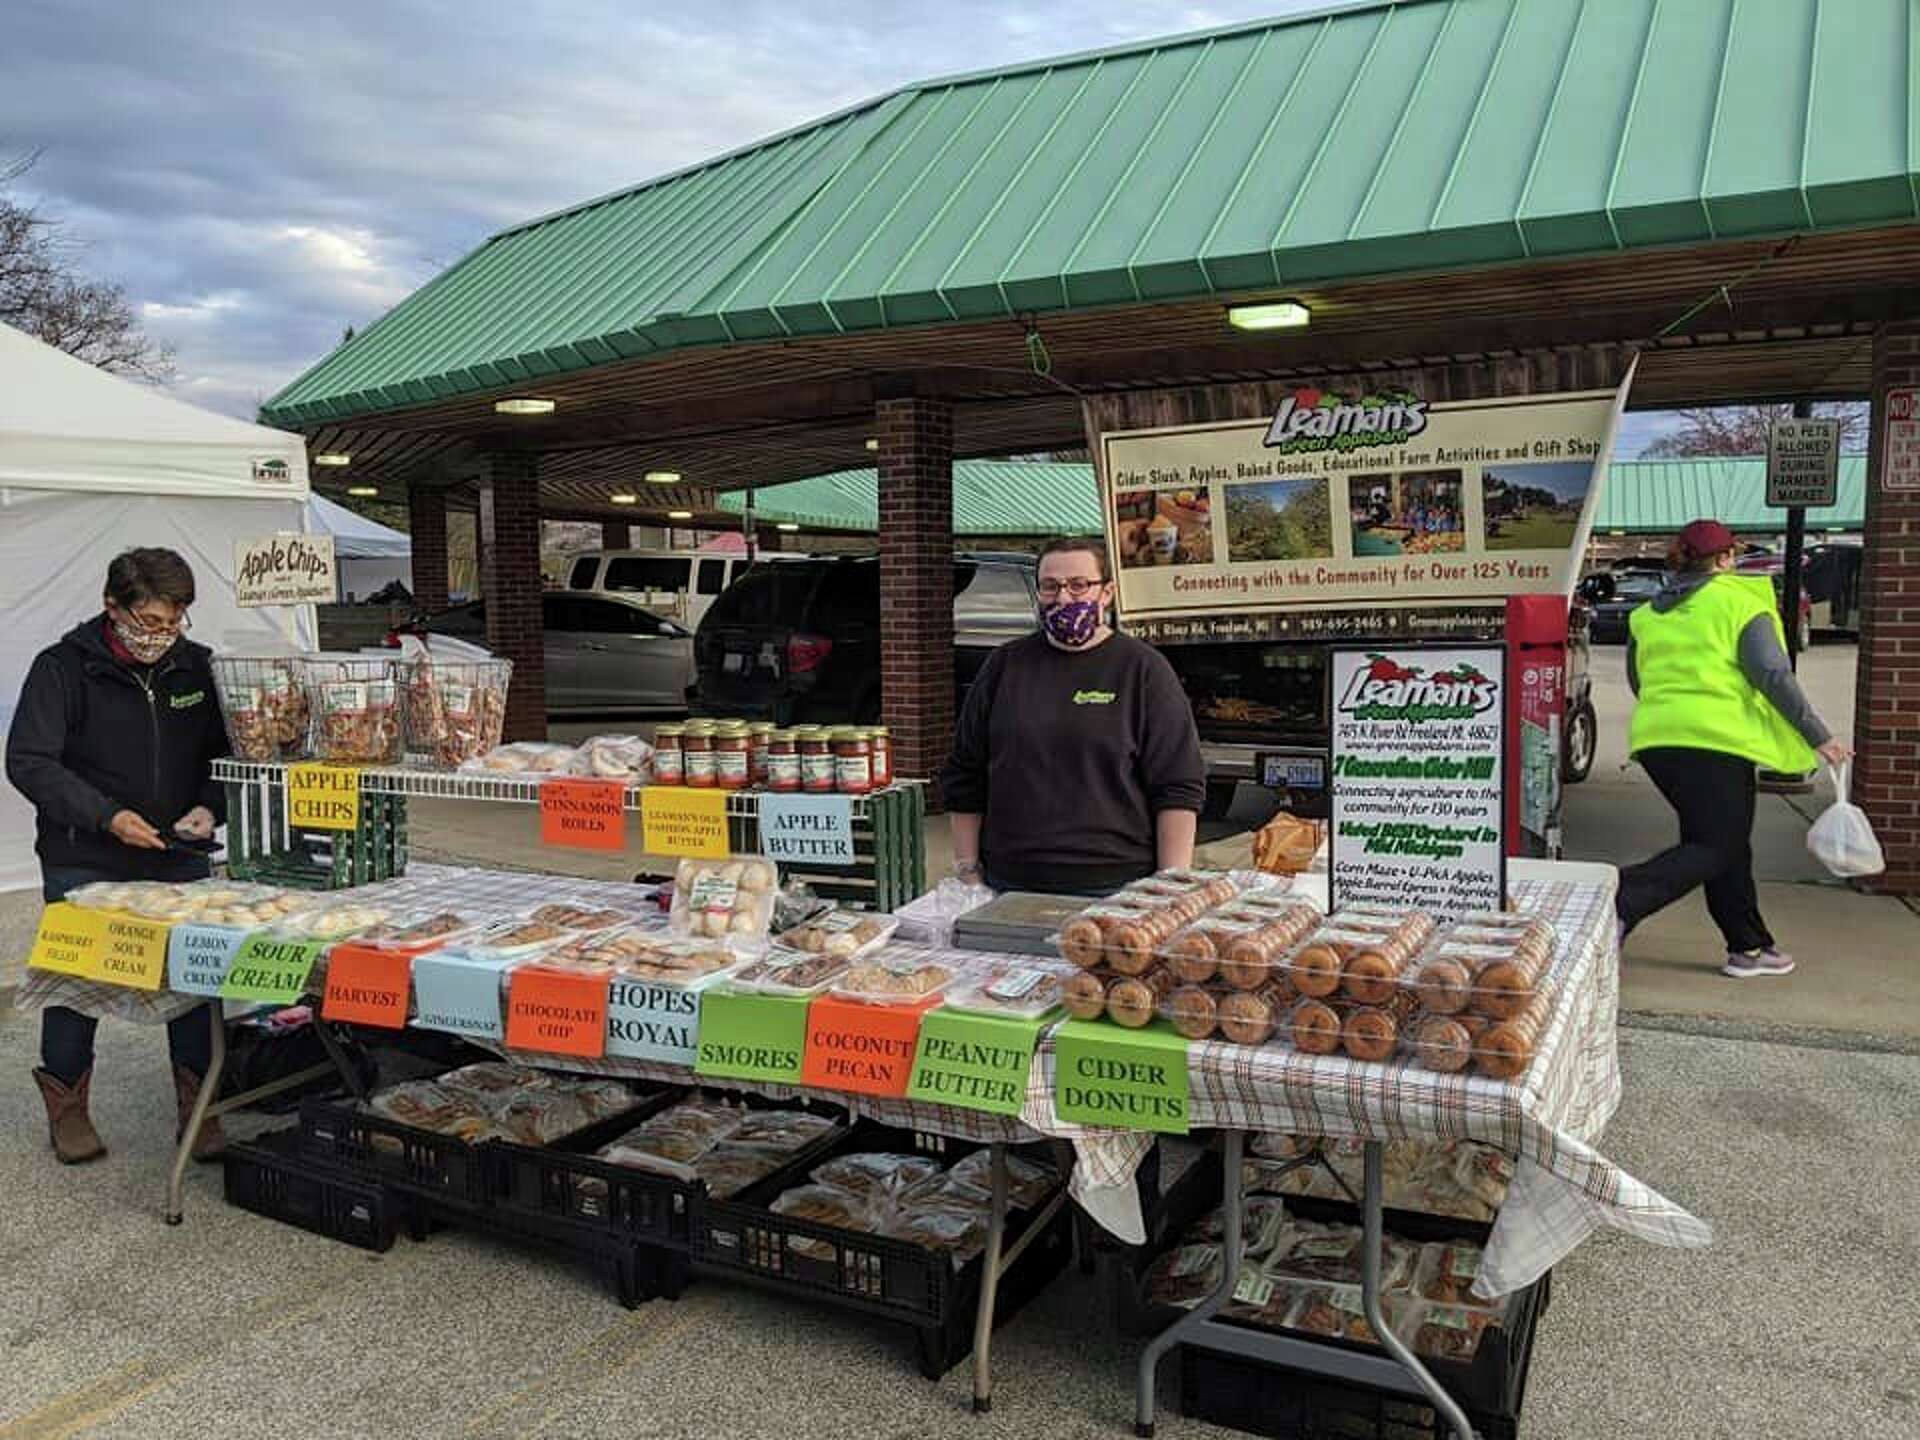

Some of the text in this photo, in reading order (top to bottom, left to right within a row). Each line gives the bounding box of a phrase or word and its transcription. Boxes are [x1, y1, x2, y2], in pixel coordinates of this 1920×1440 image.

[1779, 425, 1829, 437] NO PETS
[1117, 436, 1601, 487] Cider Slush, Apples, Baked Goods, Educational Farm Activities and Gift Shop
[238, 540, 328, 585] Apple Chips
[1173, 560, 1550, 592] Connecting with the Community for Over 125 Years
[1343, 755, 1423, 778] Generation
[1423, 756, 1463, 779] Cider
[292, 771, 354, 792] APPLE
[1333, 783, 1501, 802] Connecting agriculture to the
[293, 800, 354, 819] CHIPS
[543, 799, 622, 817] CINNAMON
[1344, 801, 1489, 818] community for 130 years
[561, 818, 606, 832] ROLLS
[774, 814, 838, 832] APPLE
[1338, 821, 1381, 837] Voted
[1415, 823, 1481, 841] Orchard
[666, 835, 705, 847] BUTTER
[768, 837, 848, 856] BUTTER
[1363, 837, 1464, 860] Mid Michigan
[1336, 861, 1364, 874] Corn
[1365, 863, 1401, 877] Maze
[1451, 869, 1494, 886] Apples
[1365, 877, 1402, 891] Barrel
[1447, 884, 1499, 900] Hayrides
[1411, 894, 1442, 909] Farm
[108, 923, 157, 941] ORANGE
[185, 935, 229, 951] LEMON
[113, 942, 145, 958] SOUR
[187, 953, 222, 969] SOUR
[250, 942, 307, 963] SOUR
[103, 958, 147, 977] CREAM
[228, 967, 303, 992] CREAM
[328, 984, 402, 1008] HARVEST
[608, 983, 696, 1015] HOPES
[514, 1001, 599, 1024] CHOCOLATE
[537, 1023, 576, 1039] CHIP
[608, 1017, 697, 1050] ROYAL
[812, 1030, 913, 1059] COCONUT
[923, 1037, 1028, 1072] PEANUT
[700, 1042, 799, 1072] SMORES
[825, 1057, 894, 1082] PECAN
[1076, 1055, 1167, 1086] CIDER
[917, 1068, 1018, 1104] BUTTER
[1064, 1086, 1184, 1119] DONUTS
